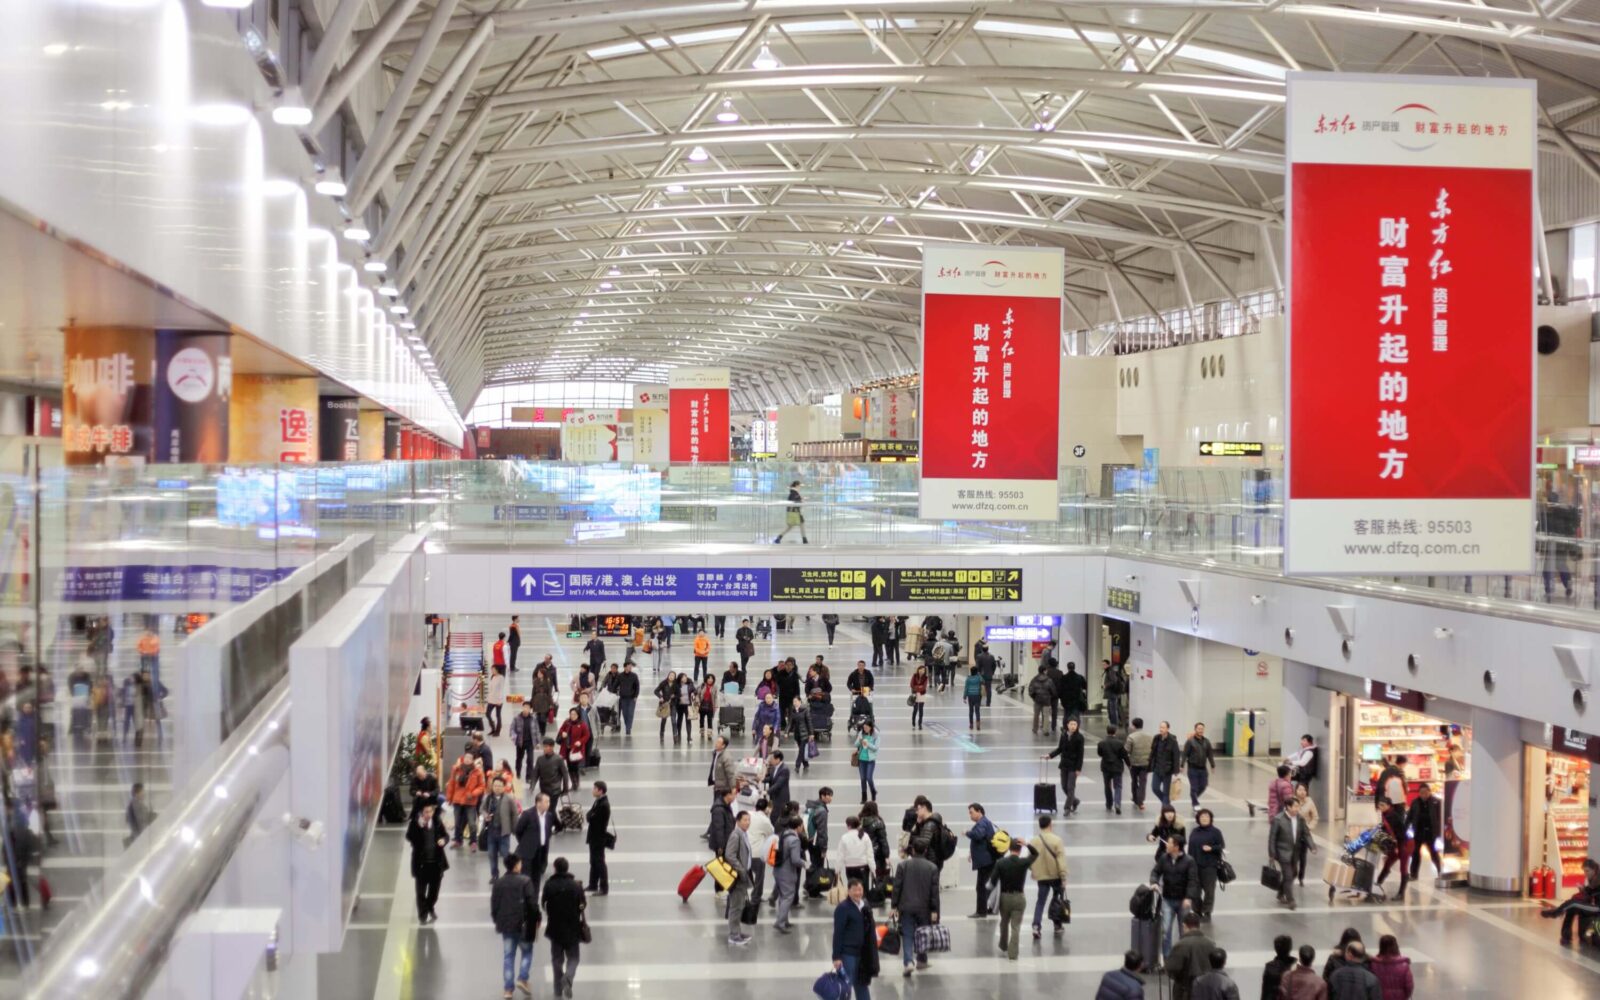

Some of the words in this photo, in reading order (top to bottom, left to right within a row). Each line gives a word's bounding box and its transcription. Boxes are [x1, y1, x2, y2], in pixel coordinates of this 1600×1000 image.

[1314, 113, 1357, 136] 东方红
[1416, 121, 1509, 138] 财富升起的地方
[1430, 188, 1454, 280] 东方红
[1432, 288, 1448, 352] 资产管理
[1378, 217, 1409, 479] 财富升起的地方
[971, 323, 991, 469] 财富升起的地方
[998, 491, 1024, 499] 95503
[952, 502, 1029, 512] www.dfzq.com.cn
[1354, 519, 1423, 535] 客服热线:
[1427, 520, 1472, 534] 95503
[1344, 541, 1480, 557] www.dfzq.com.cn
[570, 574, 678, 587] 国际/港、澳、台出发
[643, 589, 677, 597] Departures
